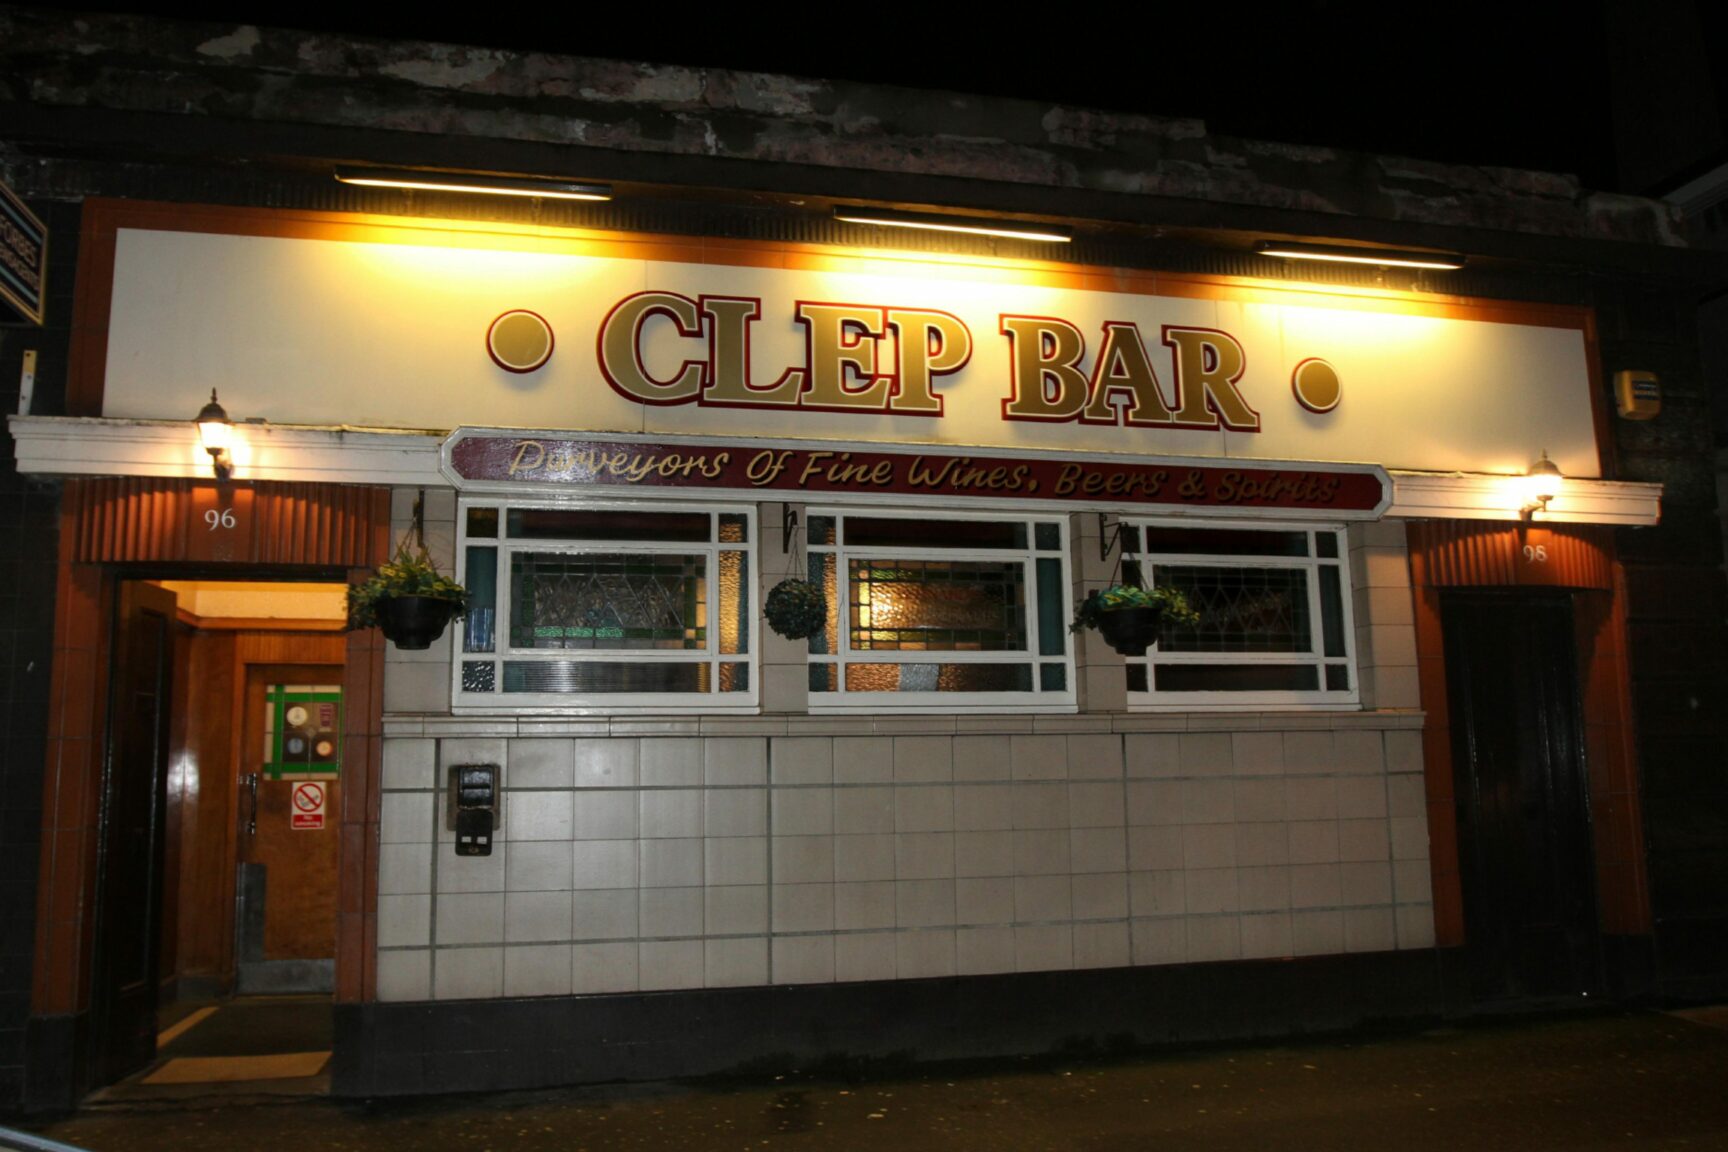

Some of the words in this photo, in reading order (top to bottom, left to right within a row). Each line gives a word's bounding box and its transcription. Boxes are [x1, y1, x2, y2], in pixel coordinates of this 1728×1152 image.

[596, 290, 972, 417] CLEP
[999, 312, 1260, 432] BAR
[509, 439, 731, 482] Purveyors
[746, 450, 794, 485] Of
[799, 452, 893, 485] Fine
[1054, 463, 1169, 495] Beers
[1178, 470, 1206, 498] &
[1215, 471, 1341, 502] Spirits
[204, 508, 236, 531] 96
[1523, 544, 1548, 564] 98
